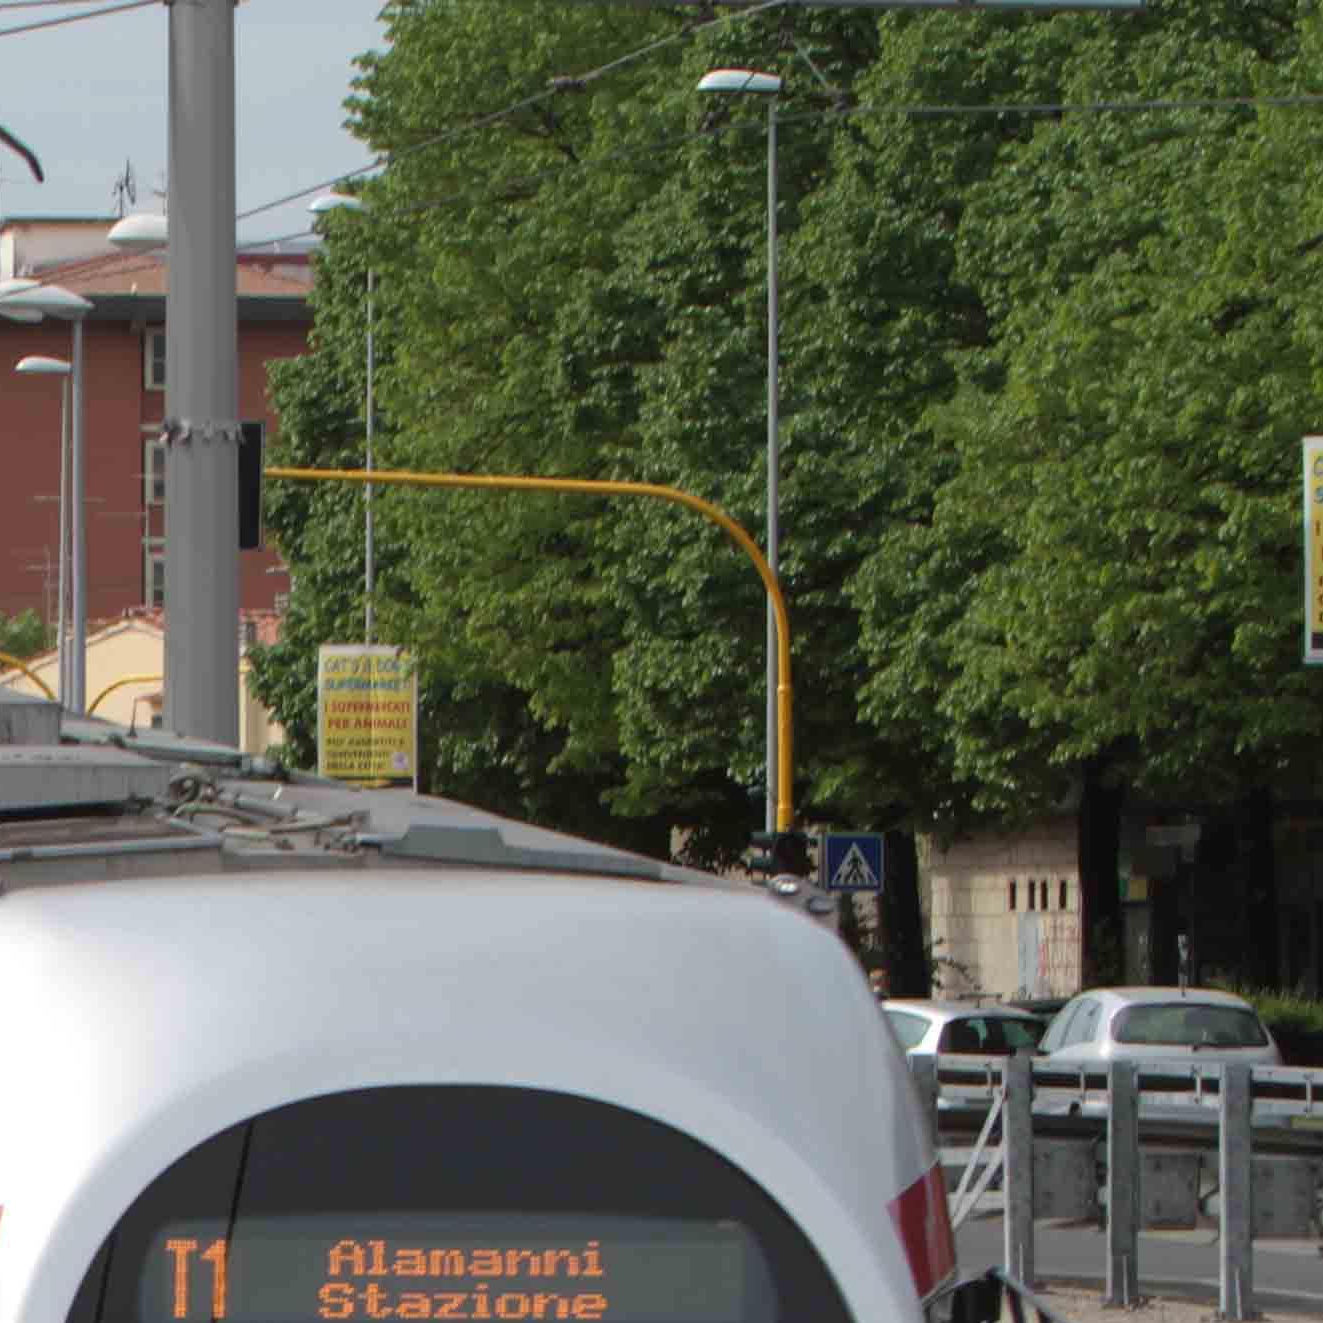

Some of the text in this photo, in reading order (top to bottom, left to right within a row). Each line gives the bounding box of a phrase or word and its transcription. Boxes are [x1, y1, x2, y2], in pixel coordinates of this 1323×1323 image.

[353, 718, 408, 729] ANIMALI
[326, 1240, 604, 1277] Alamanni
[166, 1239, 227, 1319] T1
[317, 1282, 609, 1320] Stazione
